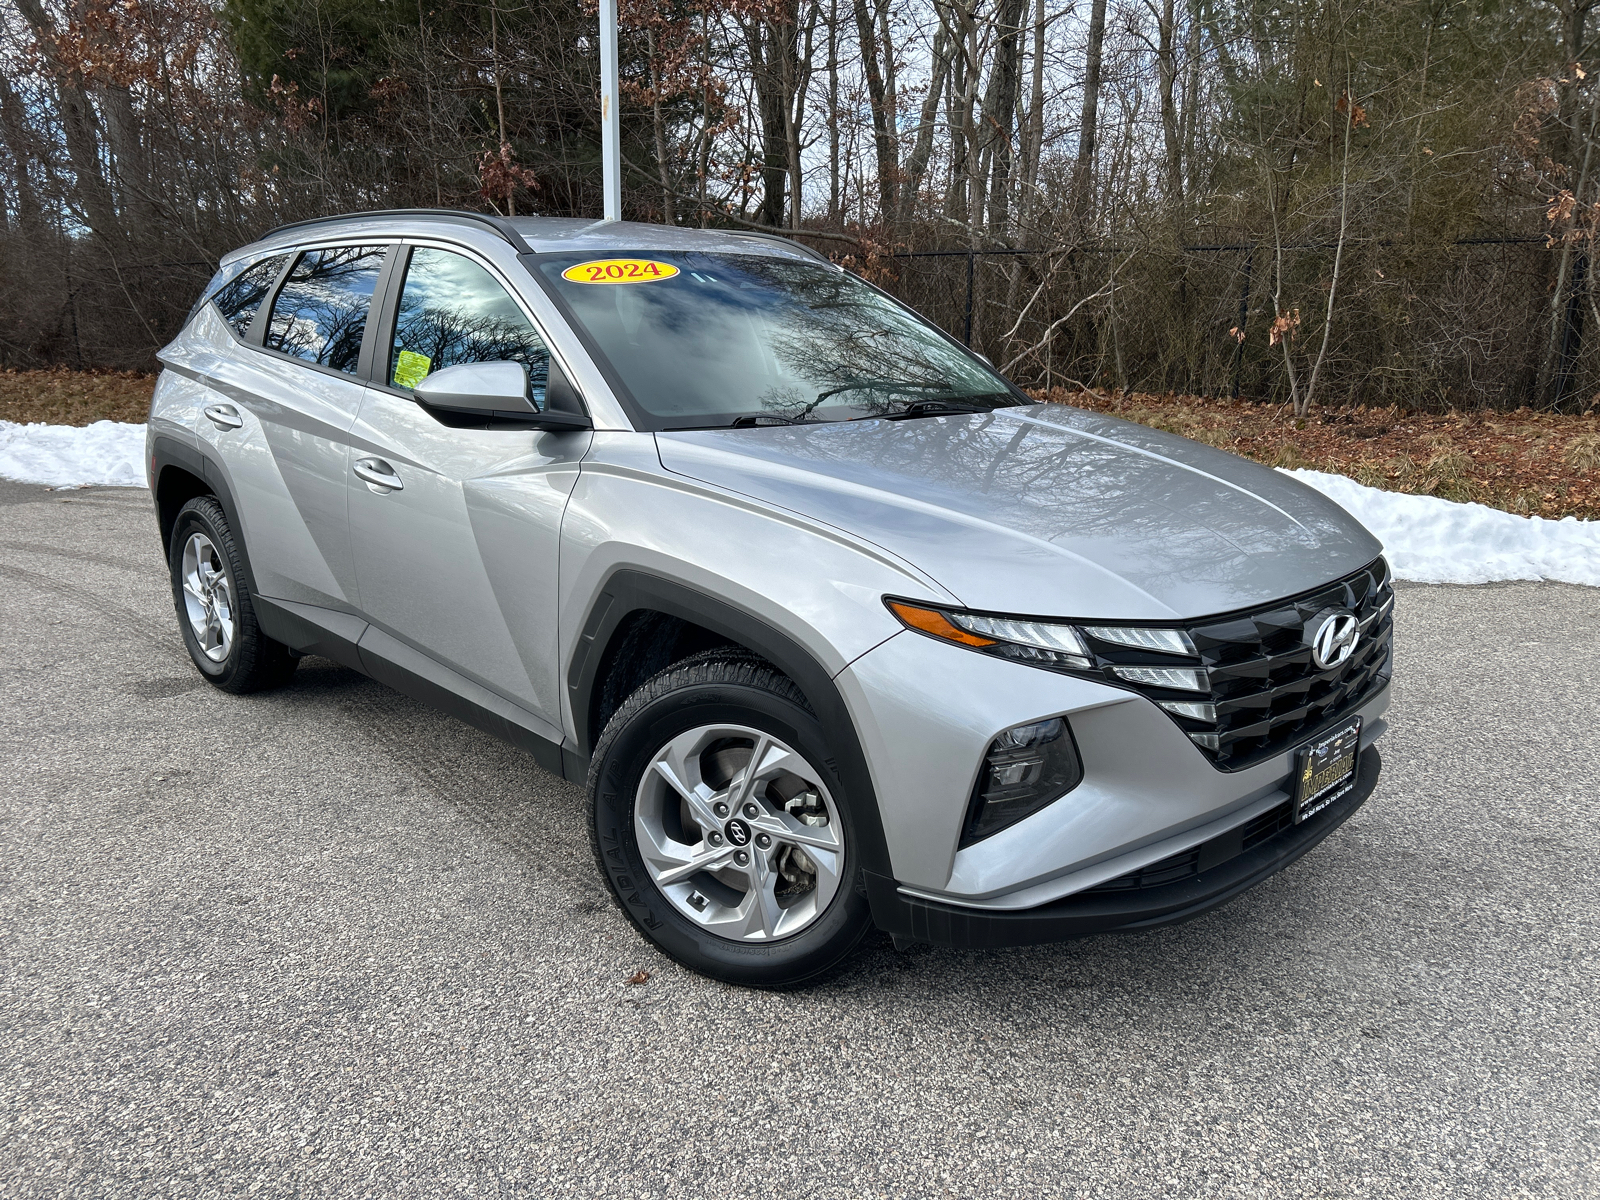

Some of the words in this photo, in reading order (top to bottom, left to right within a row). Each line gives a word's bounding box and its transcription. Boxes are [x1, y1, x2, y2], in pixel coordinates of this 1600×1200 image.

[586, 262, 662, 281] 2024
[603, 758, 623, 813] A/P
[1301, 752, 1354, 802] IMPERIAL
[603, 827, 664, 932] RADIAL
